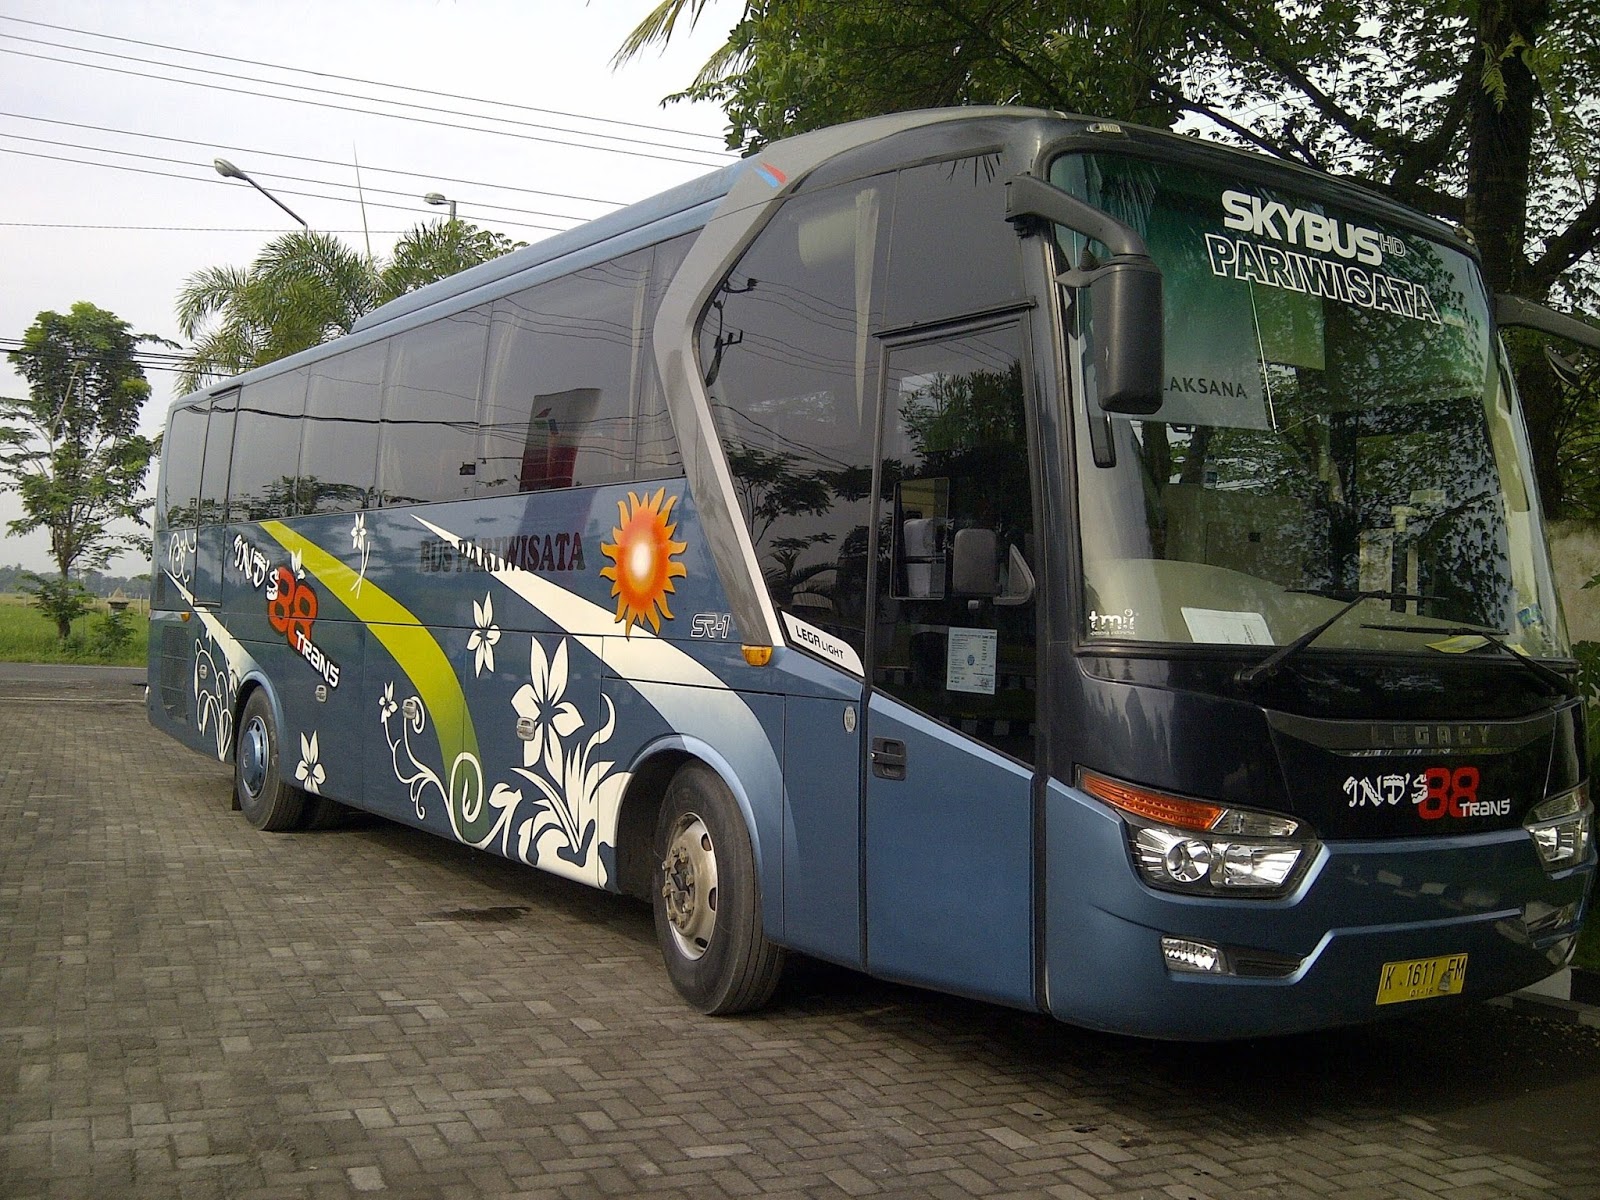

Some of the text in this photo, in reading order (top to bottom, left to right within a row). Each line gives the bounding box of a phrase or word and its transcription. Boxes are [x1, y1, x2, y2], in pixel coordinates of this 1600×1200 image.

[1221, 190, 1406, 266] SKYBUS HD
[1204, 233, 1441, 325] PARIWISATA
[420, 532, 586, 573] BUS PARIWISATA
[268, 566, 318, 650] 88
[691, 613, 731, 639] SR-1
[821, 642, 845, 660] LIGHT
[1371, 725, 1491, 745] LEGACY
[1418, 767, 1480, 820] 88
[1384, 966, 1396, 990] K
[1406, 961, 1437, 987] 1611
